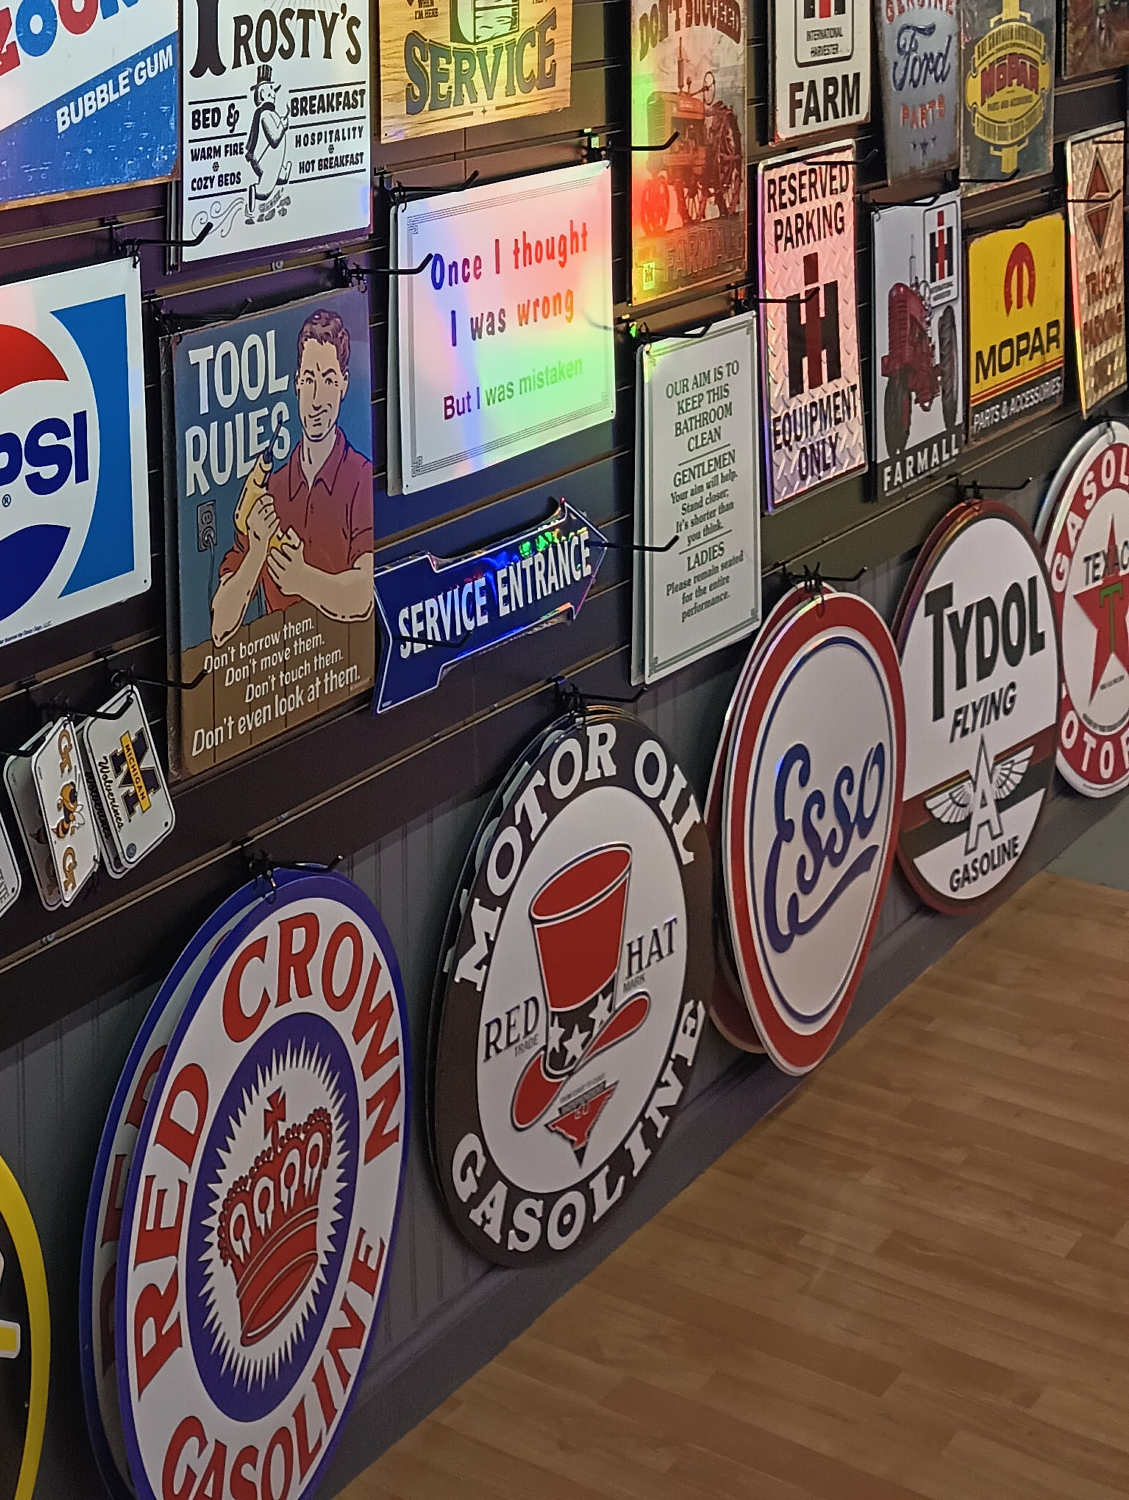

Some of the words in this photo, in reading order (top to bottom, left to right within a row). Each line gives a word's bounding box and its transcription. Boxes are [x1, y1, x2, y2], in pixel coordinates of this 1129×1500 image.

[56, 68, 130, 135] BUBBLE
[133, 43, 174, 88] GUM
[404, 6, 558, 116] SERVICE
[892, 22, 953, 92] Ford
[290, 88, 366, 118] BREAKFAST
[788, 71, 861, 129] FARM
[900, 93, 946, 129] PARTS
[294, 125, 365, 148] HOSPITALITY
[766, 162, 850, 214] RESERVED
[430, 252, 482, 291] Once
[512, 219, 589, 270] thought
[773, 200, 845, 254] PARKING
[188, 329, 290, 416] TOOL
[974, 317, 1062, 386] MOPAR
[184, 399, 292, 500] RULES
[674, 401, 733, 438] BATHROOM
[687, 425, 722, 453] CLEAN
[771, 383, 859, 452] EQUIPMENT
[673, 448, 736, 488] GENTLEMEN
[797, 435, 839, 482] ONLY
[882, 431, 961, 494] FARMALL
[686, 541, 725, 572] LADIES
[397, 576, 490, 660] SERVICE
[495, 529, 593, 618] ENTRANCE
[923, 573, 1046, 723] TYDOL
[191, 716, 235, 757] Don't
[237, 701, 272, 736] even
[274, 684, 305, 718] look
[307, 676, 322, 704] at
[324, 664, 361, 696] them.
[948, 680, 1018, 745] FLYING
[97, 754, 124, 832] Wolverines
[125, 742, 147, 802] MICHIGAN
[455, 721, 618, 993] MOTOR
[633, 737, 701, 866] OIL
[763, 740, 888, 954] Esso
[948, 833, 1020, 894] GASOLINE
[481, 994, 541, 1063] RED
[624, 916, 679, 979] HAT
[133, 1060, 209, 1402] RED
[221, 911, 402, 1166] CROWN
[451, 999, 705, 1254] GASOLINE
[161, 1226, 386, 1500] GASOLINE
